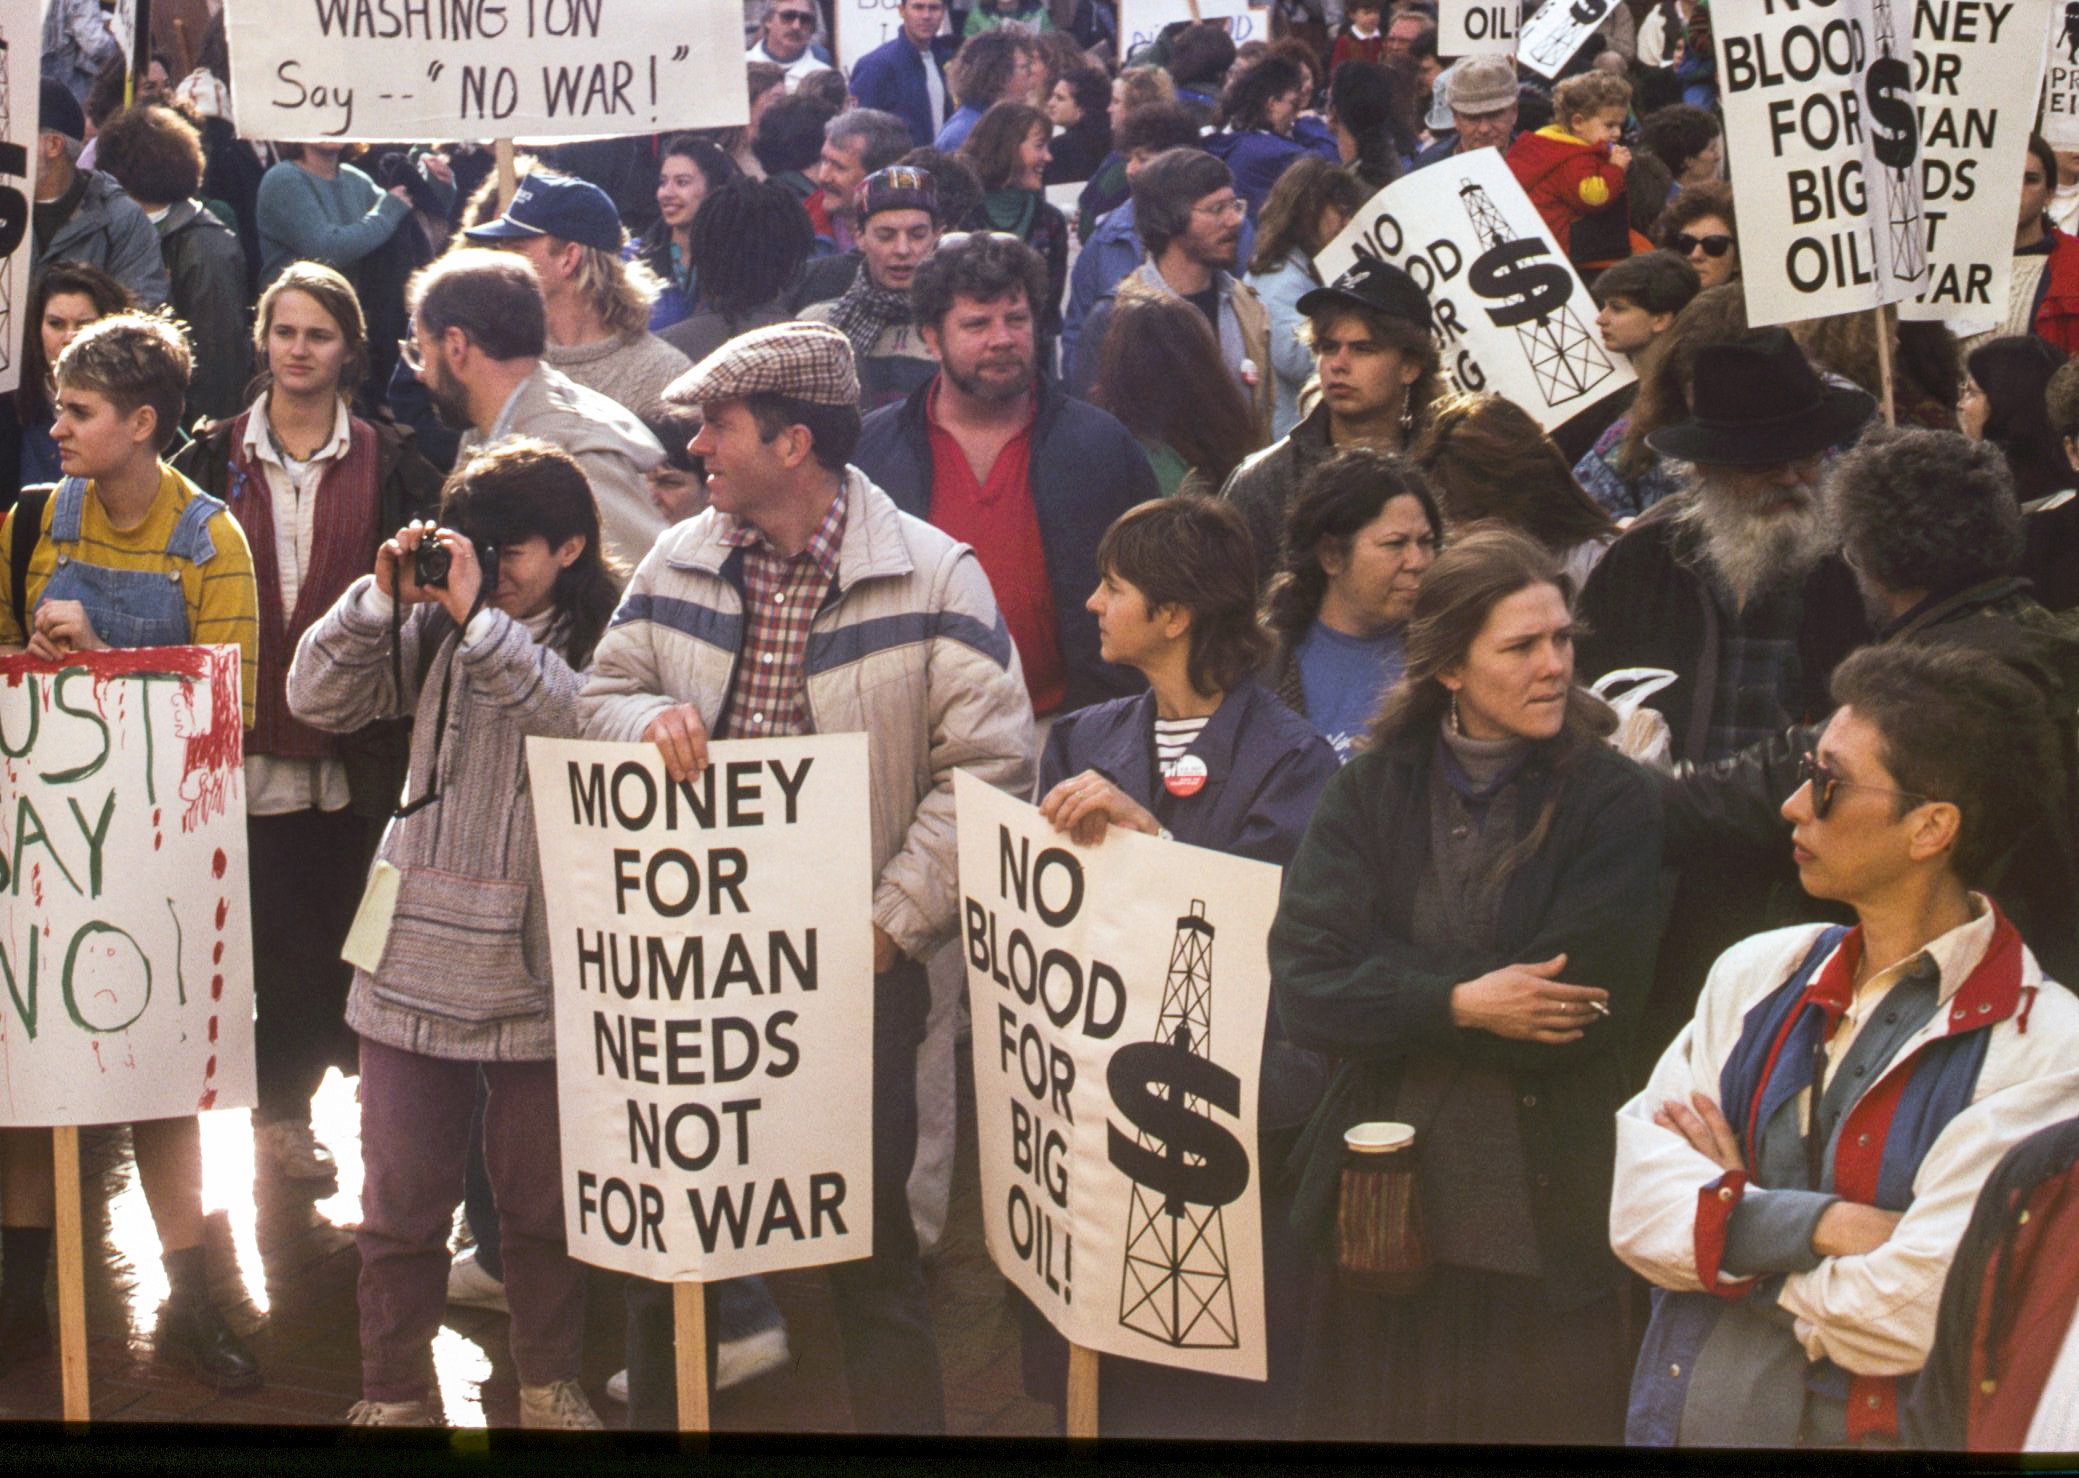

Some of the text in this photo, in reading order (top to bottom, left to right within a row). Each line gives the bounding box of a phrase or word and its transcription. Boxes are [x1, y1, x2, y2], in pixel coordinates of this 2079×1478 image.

[316, 0, 602, 41] WASHINGTON
[1722, 18, 1866, 94] BLOOD
[1912, 0, 2015, 43] NEY
[272, 60, 354, 136] Say
[1768, 89, 1864, 157] FOR
[1787, 159, 1869, 225] BIG
[1785, 226, 1879, 294] OIL!
[0, 665, 206, 806] UST
[567, 757, 814, 832] MONEY
[0, 786, 117, 900] AY
[999, 823, 1085, 928] NO
[613, 847, 750, 918] FOR
[576, 927, 818, 1001] HUMAN
[966, 896, 1127, 1040] BLOOD
[593, 1009, 800, 1086] NEEDS
[998, 1002, 1076, 1127] FOR
[626, 1097, 762, 1172] NOT
[1010, 1097, 1069, 1209] BIG
[577, 1169, 849, 1254] FOR WAR
[1007, 1184, 1072, 1306] OIL!
